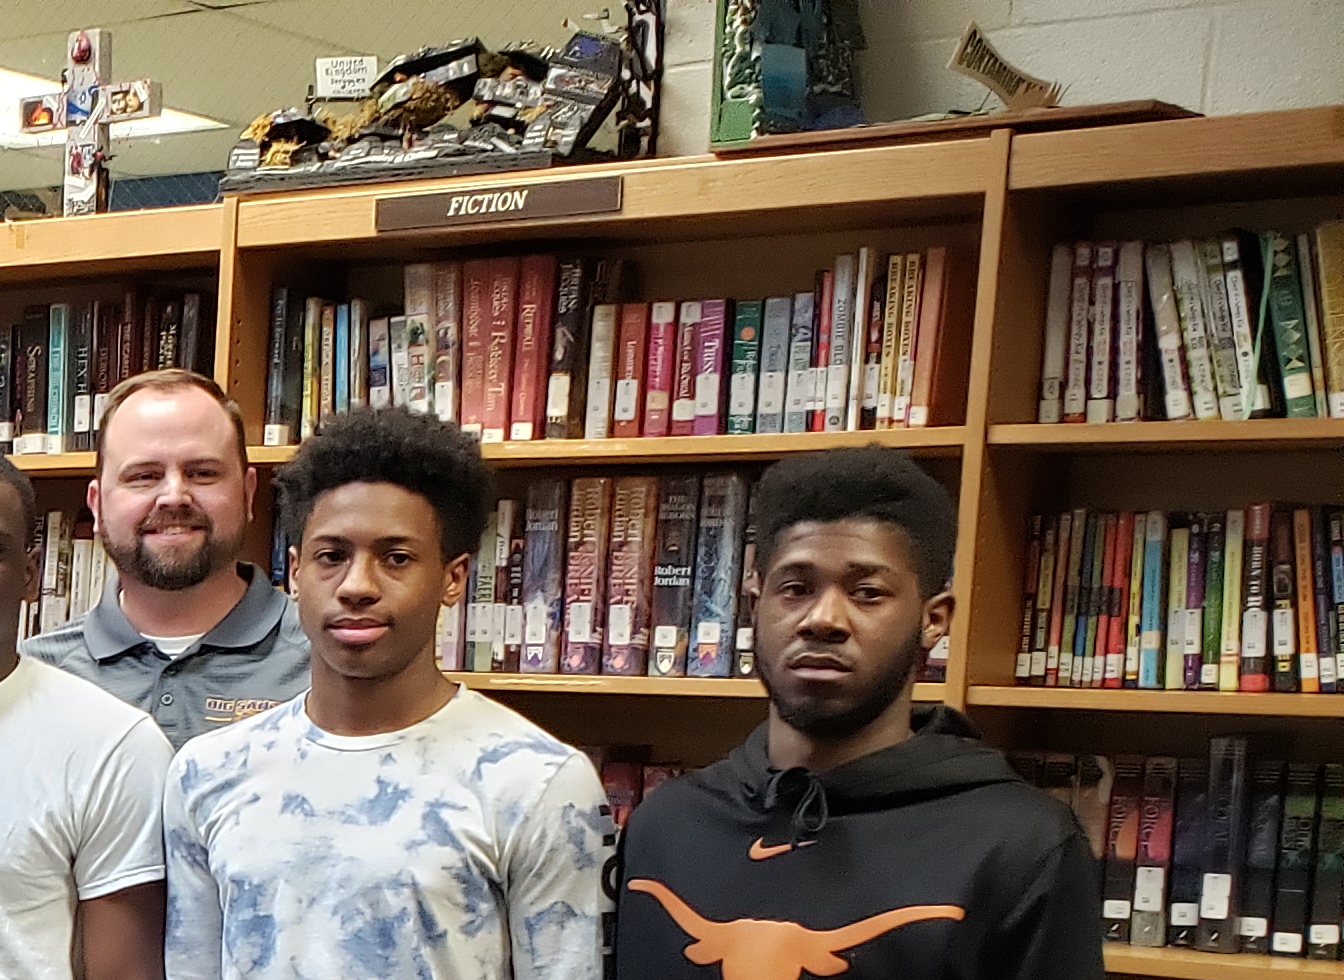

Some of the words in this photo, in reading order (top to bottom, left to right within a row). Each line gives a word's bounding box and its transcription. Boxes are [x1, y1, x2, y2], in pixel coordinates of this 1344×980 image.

[447, 190, 528, 217] FICTION
[887, 260, 900, 322] BREAKING
[904, 259, 917, 320] BREAKING
[521, 303, 538, 352] REDWALL
[835, 298, 847, 341] ZOMBIE
[485, 383, 505, 411] Tam
[525, 519, 558, 532] Jordan
[526, 508, 558, 520] Robert
[654, 565, 692, 577] Robert
[1250, 546, 1265, 576] BORN
[653, 576, 691, 588] Jordan
[1249, 579, 1261, 593] TO
[207, 700, 234, 711] BIG
